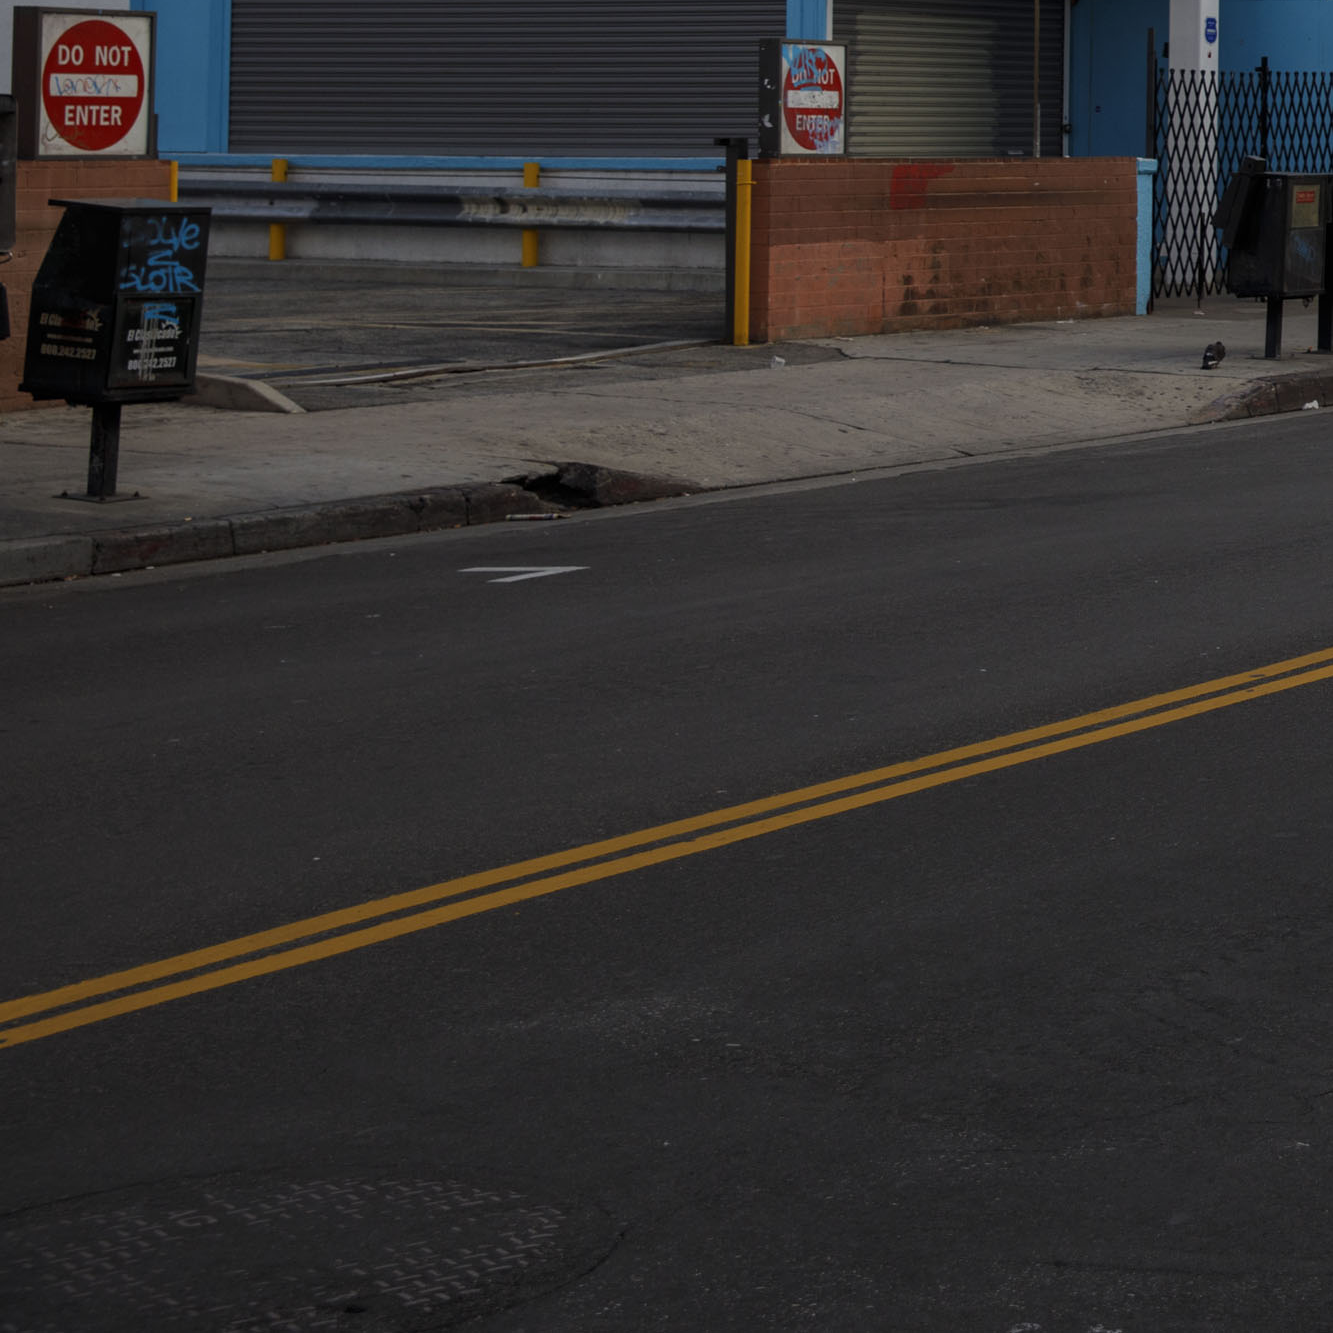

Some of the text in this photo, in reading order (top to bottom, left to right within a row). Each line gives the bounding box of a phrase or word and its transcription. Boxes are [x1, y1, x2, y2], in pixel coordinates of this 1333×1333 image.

[58, 44, 132, 66] DO NOT
[64, 104, 123, 126] ENTER
